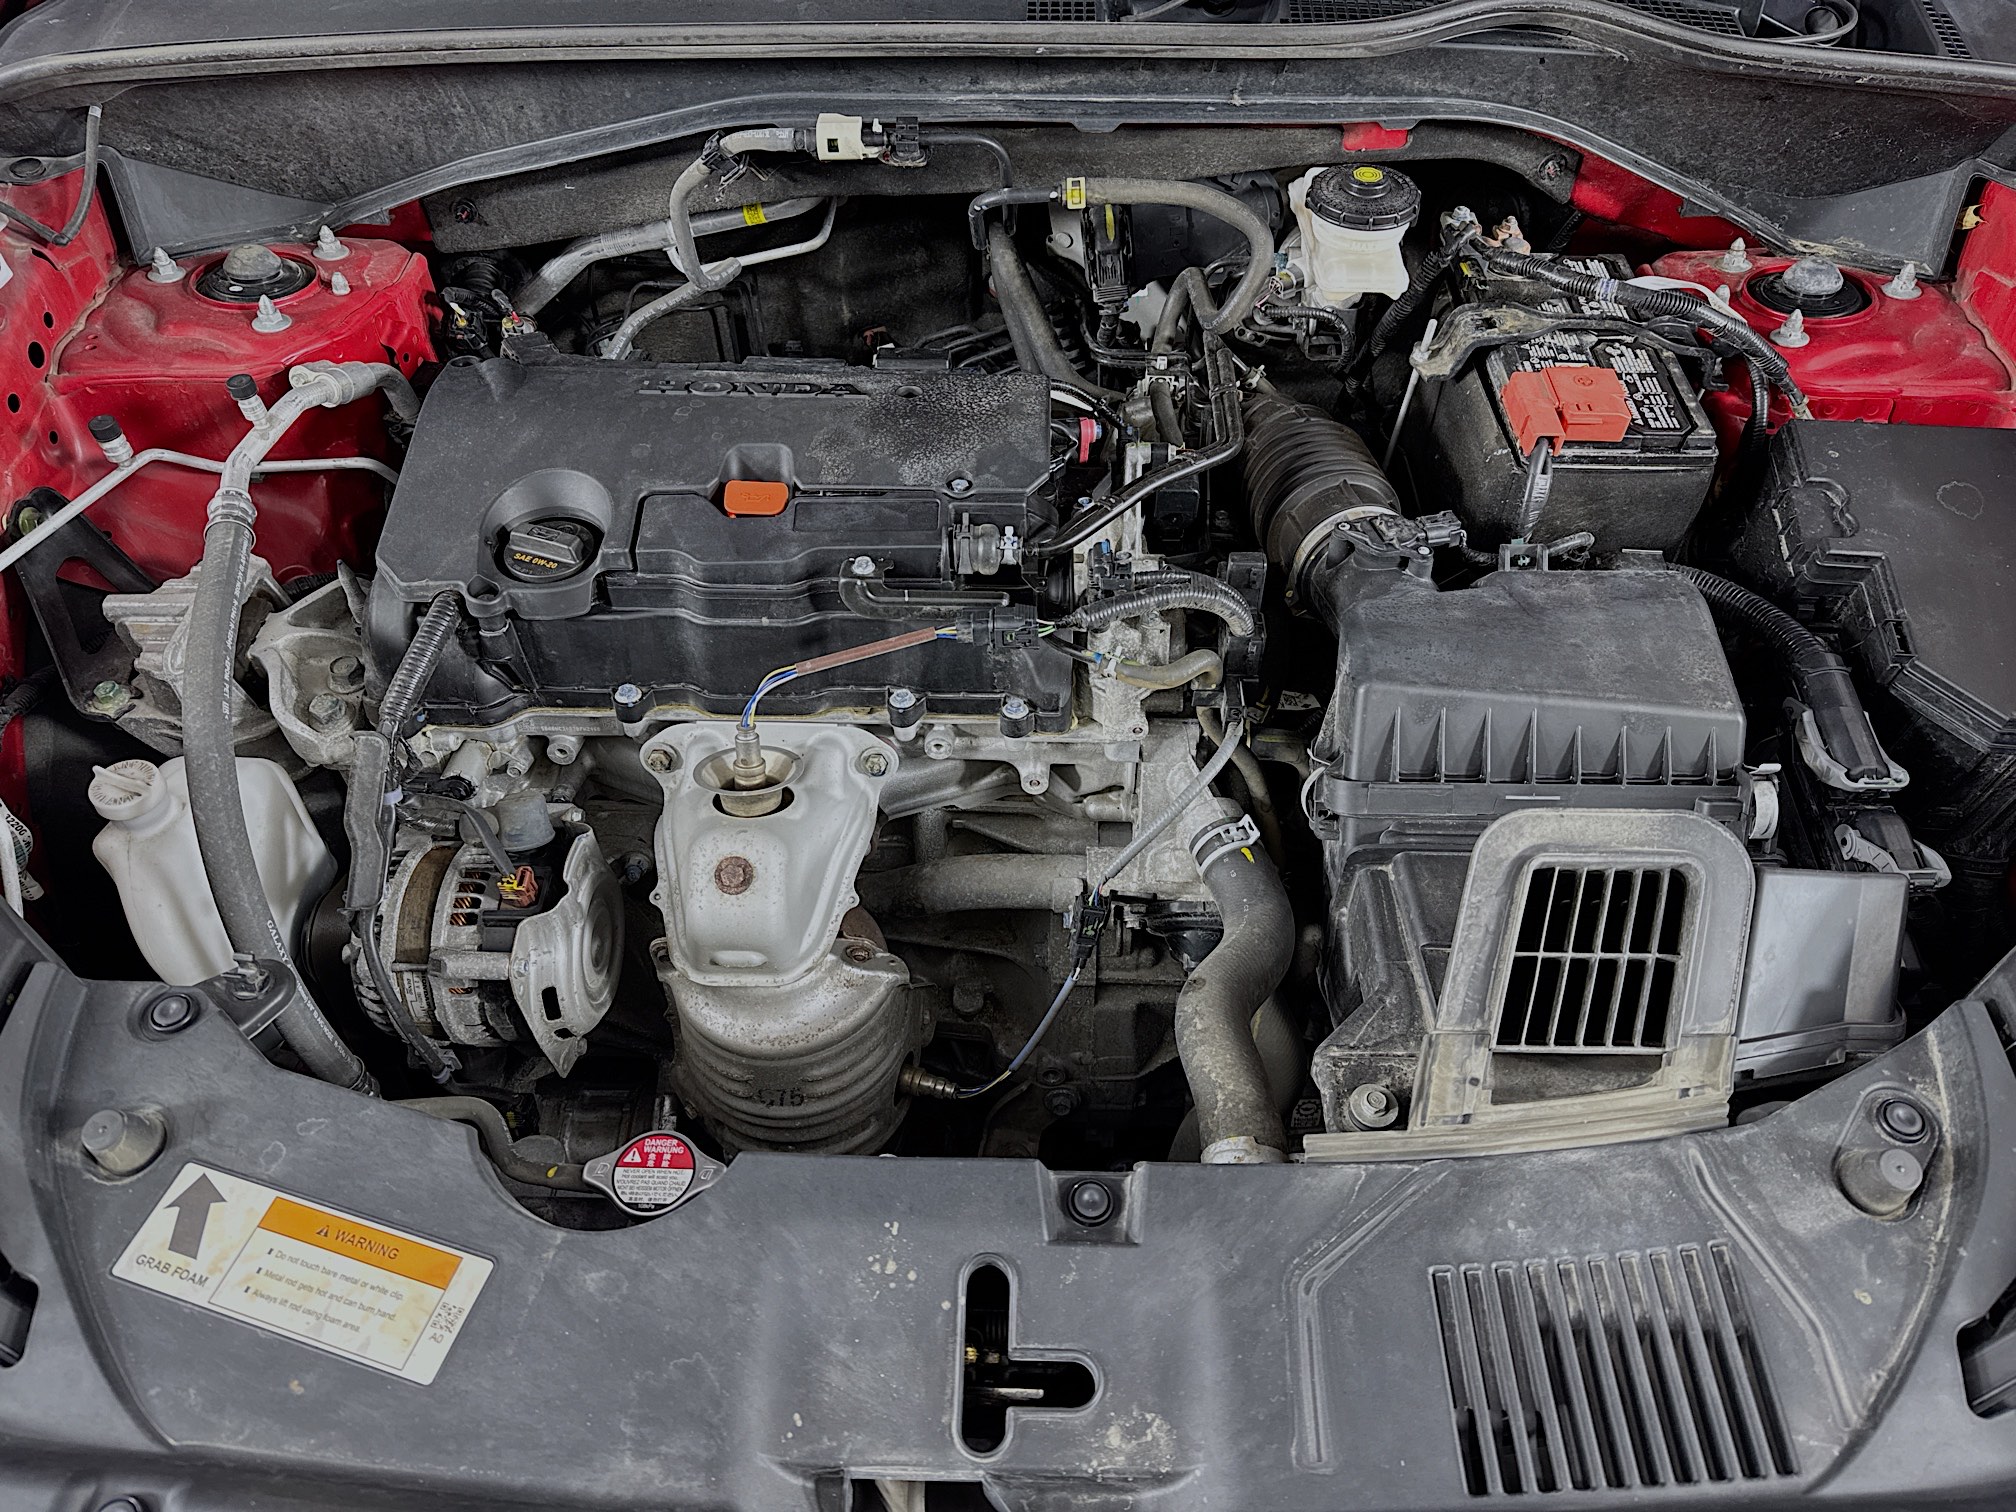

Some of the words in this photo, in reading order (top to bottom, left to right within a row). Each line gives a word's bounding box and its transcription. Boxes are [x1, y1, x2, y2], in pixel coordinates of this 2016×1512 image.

[637, 380, 871, 399] HONDA
[513, 552, 532, 562] SAE
[532, 556, 558, 569] 0W-20
[266, 919, 289, 961] GALAXY
[644, 1138, 678, 1146] DANGER
[644, 1146, 684, 1154] WARNUNG
[334, 1230, 399, 1260] WARNING
[135, 1254, 171, 1274] GRAB
[172, 1266, 210, 1288] FOAM
[274, 1250, 286, 1260] Do
[287, 1255, 299, 1264] not
[300, 1259, 320, 1272] touch
[322, 1265, 339, 1278] bare
[339, 1273, 360, 1287] metal
[370, 1283, 389, 1296] white
[264, 1269, 282, 1282] Metal
[284, 1276, 298, 1287] rod
[297, 1282, 314, 1294] gets
[315, 1287, 328, 1298] hot
[328, 1292, 344, 1304] and
[344, 1298, 357, 1308] can
[252, 1288, 278, 1304] Always
[279, 1296, 289, 1306] lift
[289, 1302, 302, 1312] rod
[302, 1307, 322, 1321] using
[323, 1312, 343, 1326] foam
